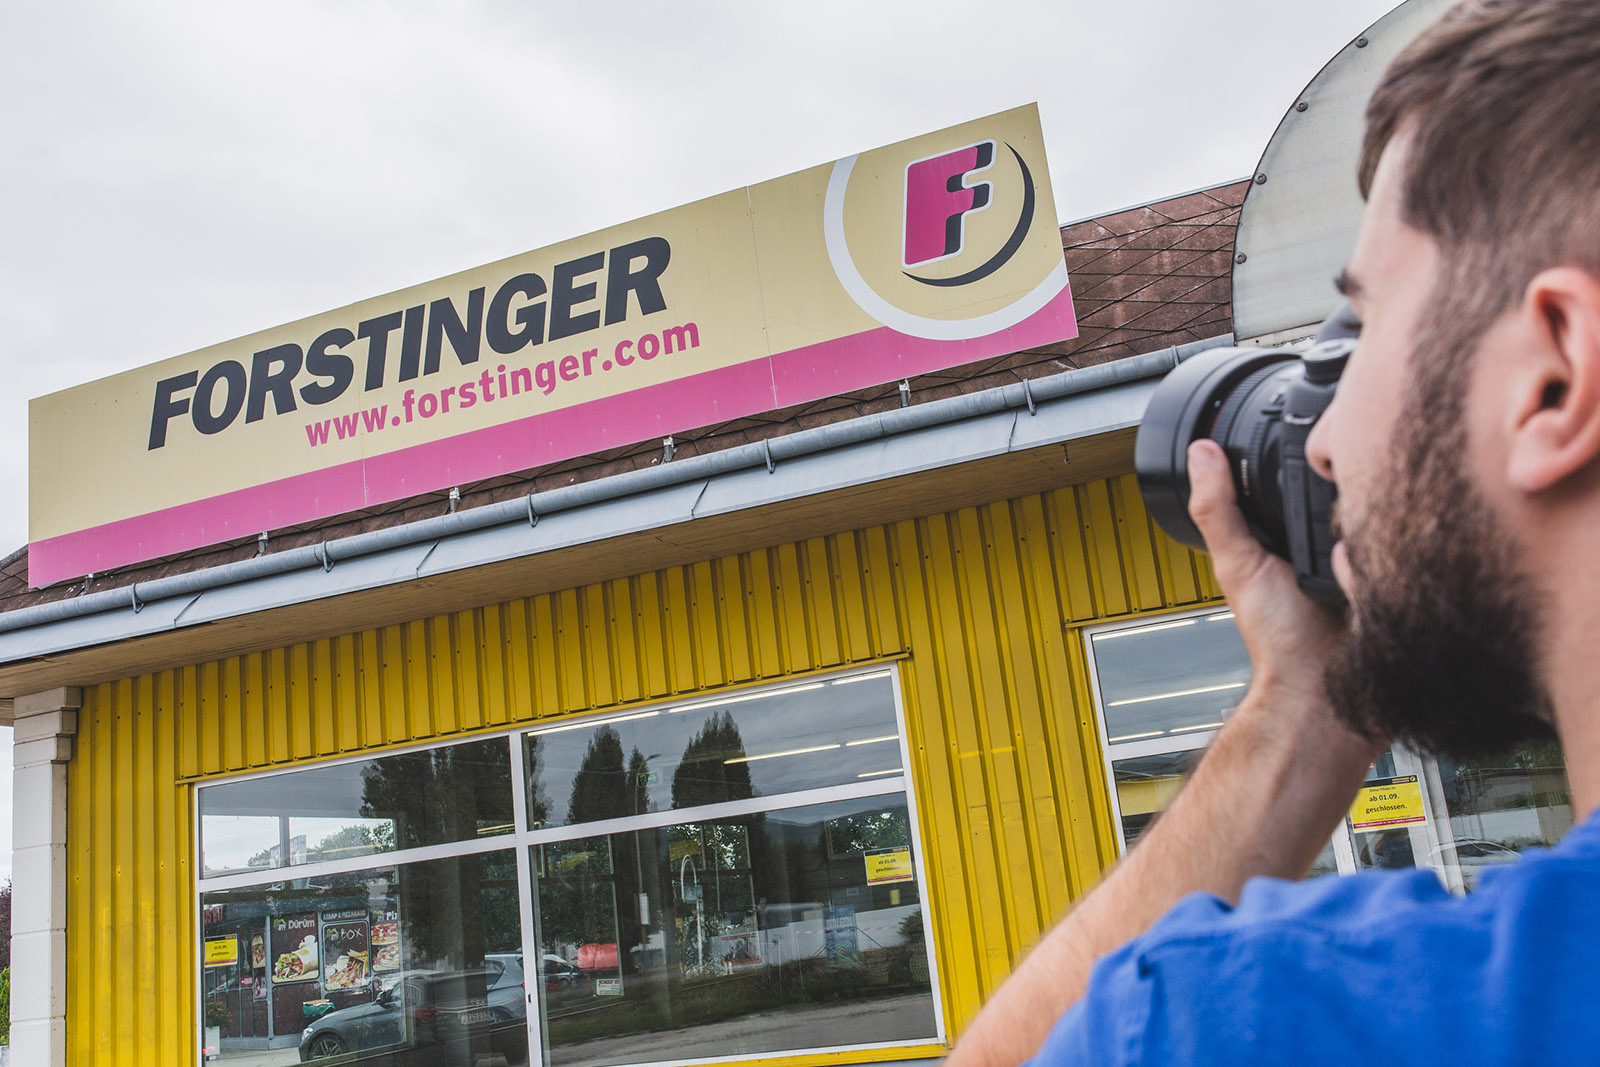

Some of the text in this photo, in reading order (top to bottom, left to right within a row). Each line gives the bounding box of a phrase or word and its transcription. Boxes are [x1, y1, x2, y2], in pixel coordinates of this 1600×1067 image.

[903, 140, 994, 267] F
[147, 237, 671, 451] FORSTINGER
[305, 322, 700, 447] www.forstinger.com
[1365, 803, 1408, 815] geschlossen.
[1378, 793, 1400, 801] 01.09.
